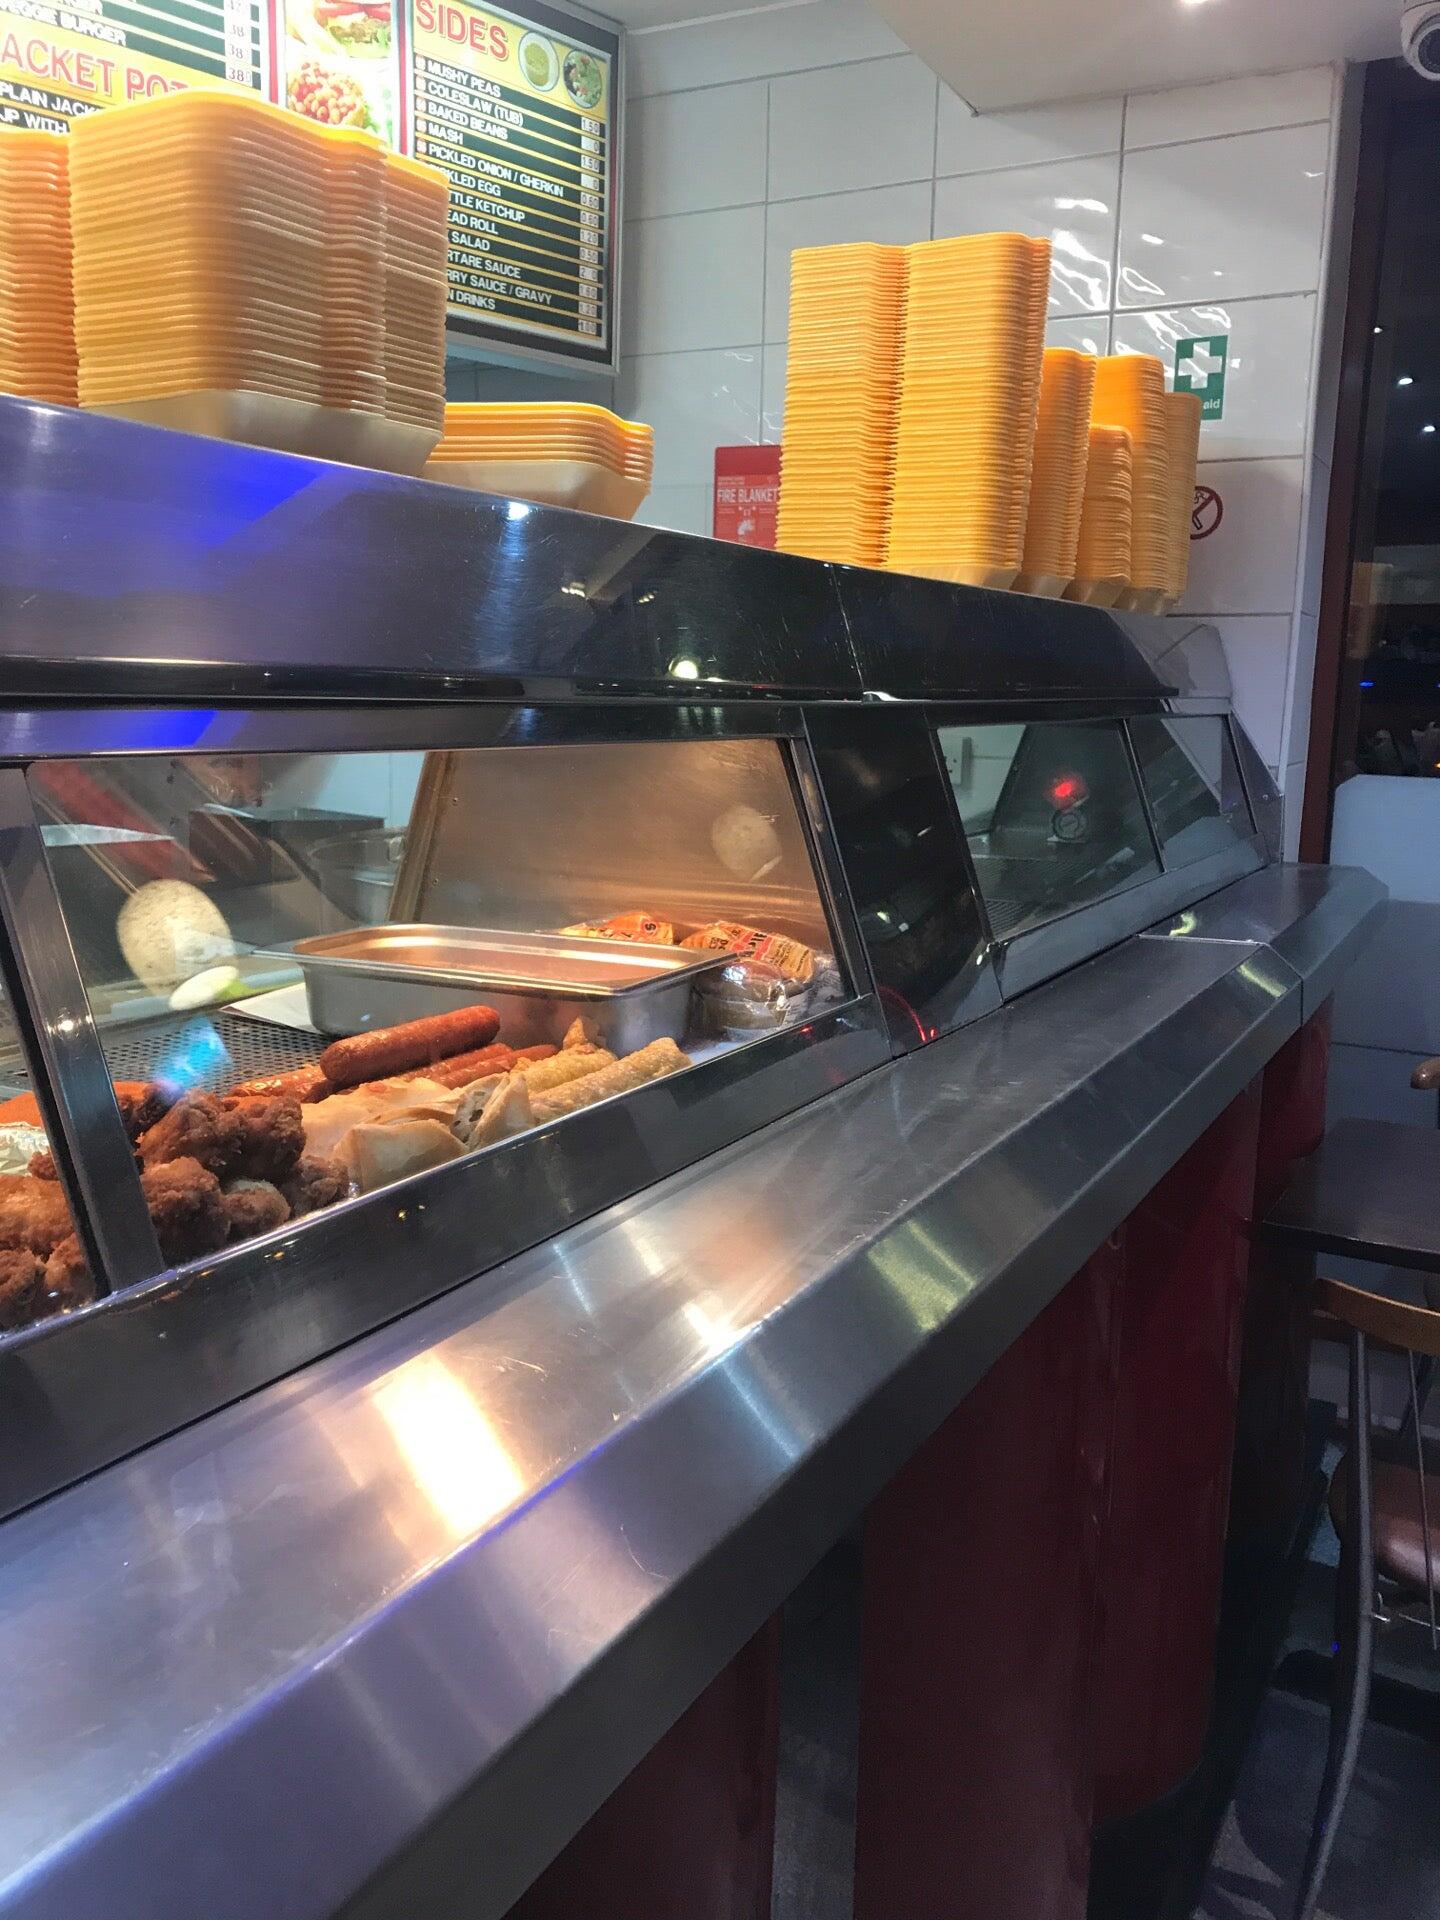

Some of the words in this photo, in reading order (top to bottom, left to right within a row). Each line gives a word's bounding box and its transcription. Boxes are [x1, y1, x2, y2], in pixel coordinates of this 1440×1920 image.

[416, 0, 509, 61] SIDES
[428, 59, 470, 86] MUSHY
[471, 73, 501, 98] PEAS
[0, 81, 48, 108] PLAIN
[51, 97, 100, 116] JACK
[428, 79, 494, 113] COLESLAW
[494, 103, 524, 126] (TUB)
[23, 112, 67, 133] WITH
[428, 99, 469, 126] BAKED
[470, 115, 508, 140] BEANS
[428, 120, 464, 145] MASH
[428, 143, 476, 168] PICKLED
[477, 160, 512, 181] ONION
[519, 174, 564, 197] GHERKIN
[477, 179, 501, 197] EGG
[449, 190, 474, 208] TTLE
[475, 198, 526, 222] KETCHUP
[447, 209, 468, 226] EAD
[470, 216, 498, 235] ROLL
[451, 231, 491, 251] SALAD
[447, 250, 483, 269] RTARE
[484, 260, 521, 279] SAUCE
[446, 269, 468, 284] RRY
[470, 275, 507, 294] SAUCE
[515, 286, 552, 305] GRAVY
[456, 291, 496, 310] DRINKS
[717, 488, 736, 503] FIRE
[738, 487, 777, 503] BLANKET
